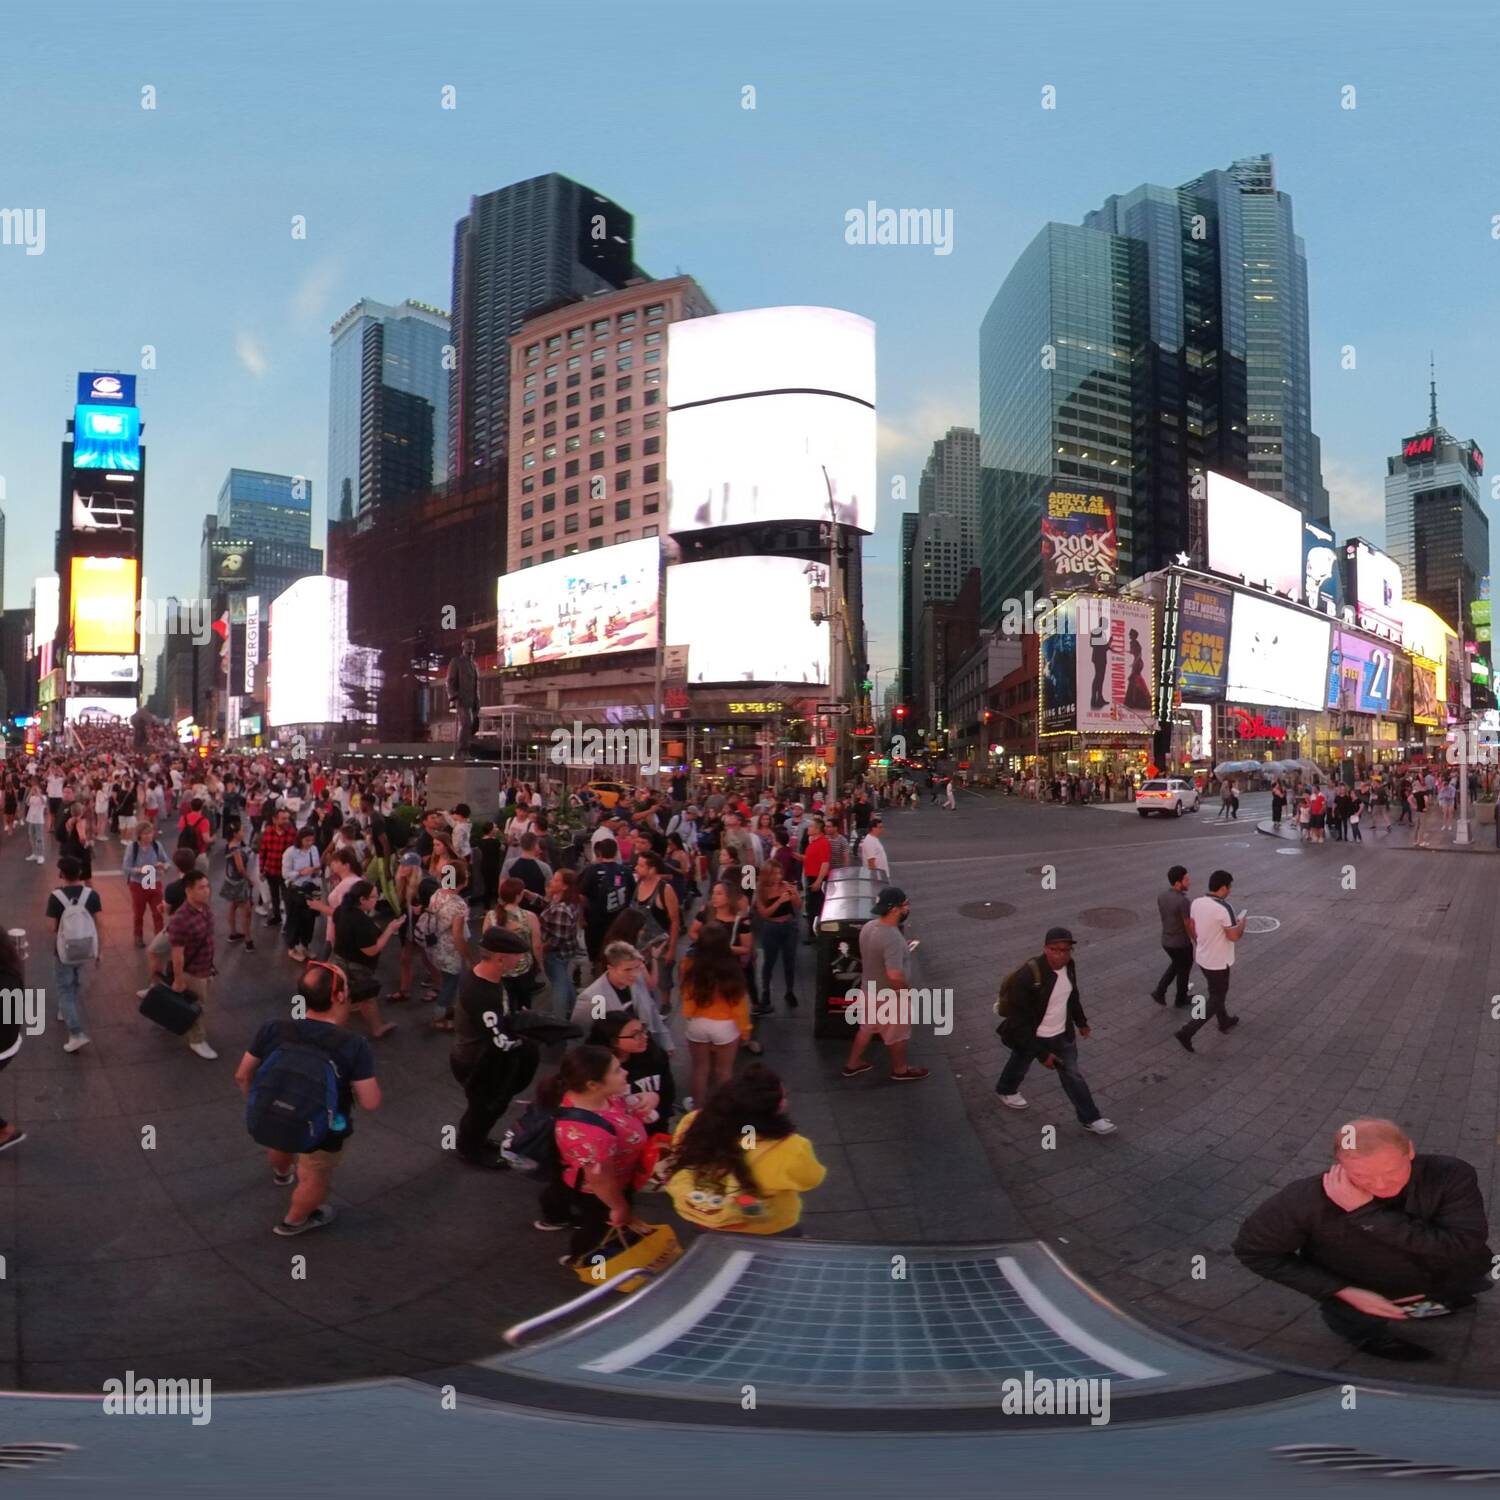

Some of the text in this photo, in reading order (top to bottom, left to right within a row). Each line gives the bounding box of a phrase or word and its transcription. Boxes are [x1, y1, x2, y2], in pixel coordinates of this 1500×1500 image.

[1048, 491, 1104, 503] ABOUT AS
[1048, 498, 1087, 507] GUILTY
[1048, 504, 1112, 516] PLEASURES
[1045, 529, 1118, 560] ROCK
[1056, 553, 1116, 576] AGES
[1184, 598, 1201, 611] BEST
[1111, 619, 1126, 656] PRETTY
[1182, 630, 1225, 649] COME
[247, 609, 259, 689] COVERGIRL
[1181, 657, 1222, 676] AWAY
[1370, 649, 1394, 701] 21
[1111, 663, 1126, 704] WOMAN
